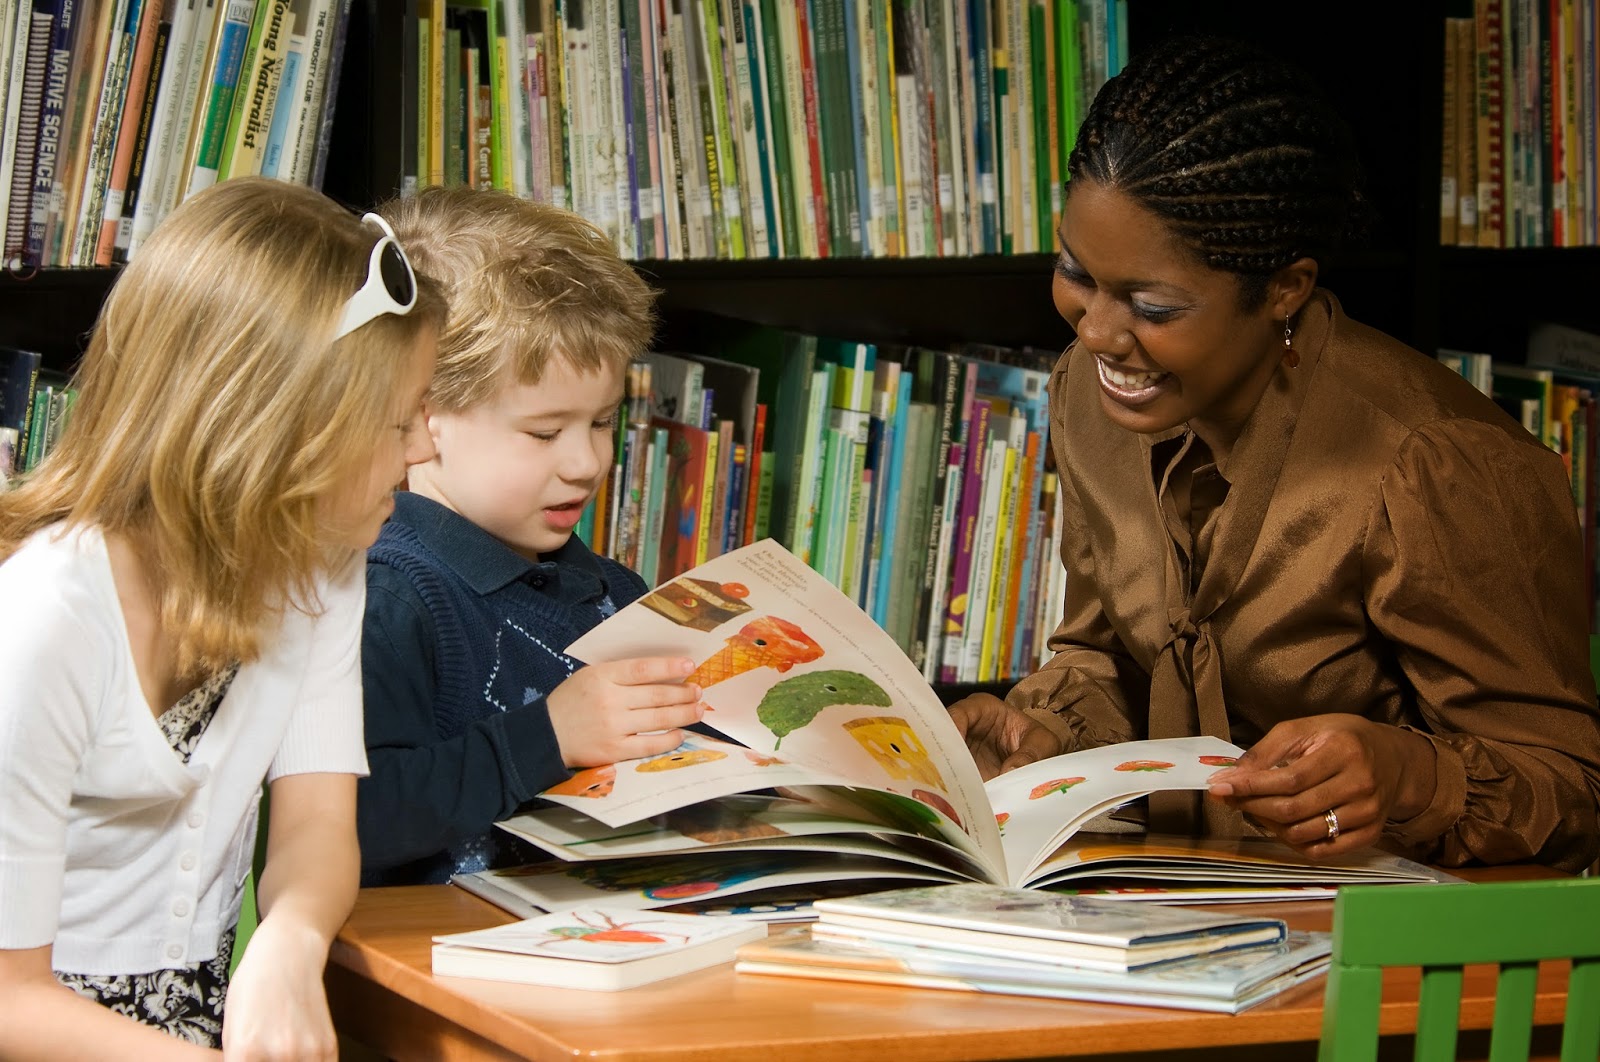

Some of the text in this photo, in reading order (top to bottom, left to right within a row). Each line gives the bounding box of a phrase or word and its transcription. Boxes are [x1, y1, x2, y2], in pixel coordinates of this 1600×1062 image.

[61, 0, 73, 28] CAJETE
[317, 11, 326, 27] THE
[308, 29, 321, 78] CURIOSITY
[979, 48, 988, 83] AROUND
[46, 49, 70, 110] NATIVE
[243, 0, 290, 148] Young Naturalist
[102, 89, 110, 104] and
[147, 82, 156, 102] SCIENCE
[175, 40, 205, 155] HOW NATURE WORKS
[260, 58, 283, 133] NATUREWATCH
[304, 80, 313, 102] CLUB
[1543, 39, 1552, 145] DOWN TO EARTH
[790, 94, 798, 135] GROWING
[36, 114, 60, 188] SCIENCE
[479, 127, 491, 178] The Carrot
[574, 134, 583, 169] Flowers
[586, 135, 595, 169] Flowers
[704, 135, 720, 200] FLOWERS
[28, 369, 38, 399] Thoreau
[692, 372, 701, 397] THE
[945, 376, 956, 401] color
[943, 402, 953, 429] book
[981, 408, 988, 419] Do
[942, 431, 950, 441] of
[978, 421, 986, 439] Bees
[937, 443, 948, 478] insects
[849, 492, 860, 523] World
[985, 515, 993, 529] The
[929, 505, 943, 547] Michael
[983, 532, 991, 548] Very
[980, 551, 988, 571] Quiet
[976, 573, 985, 600] Cricket
